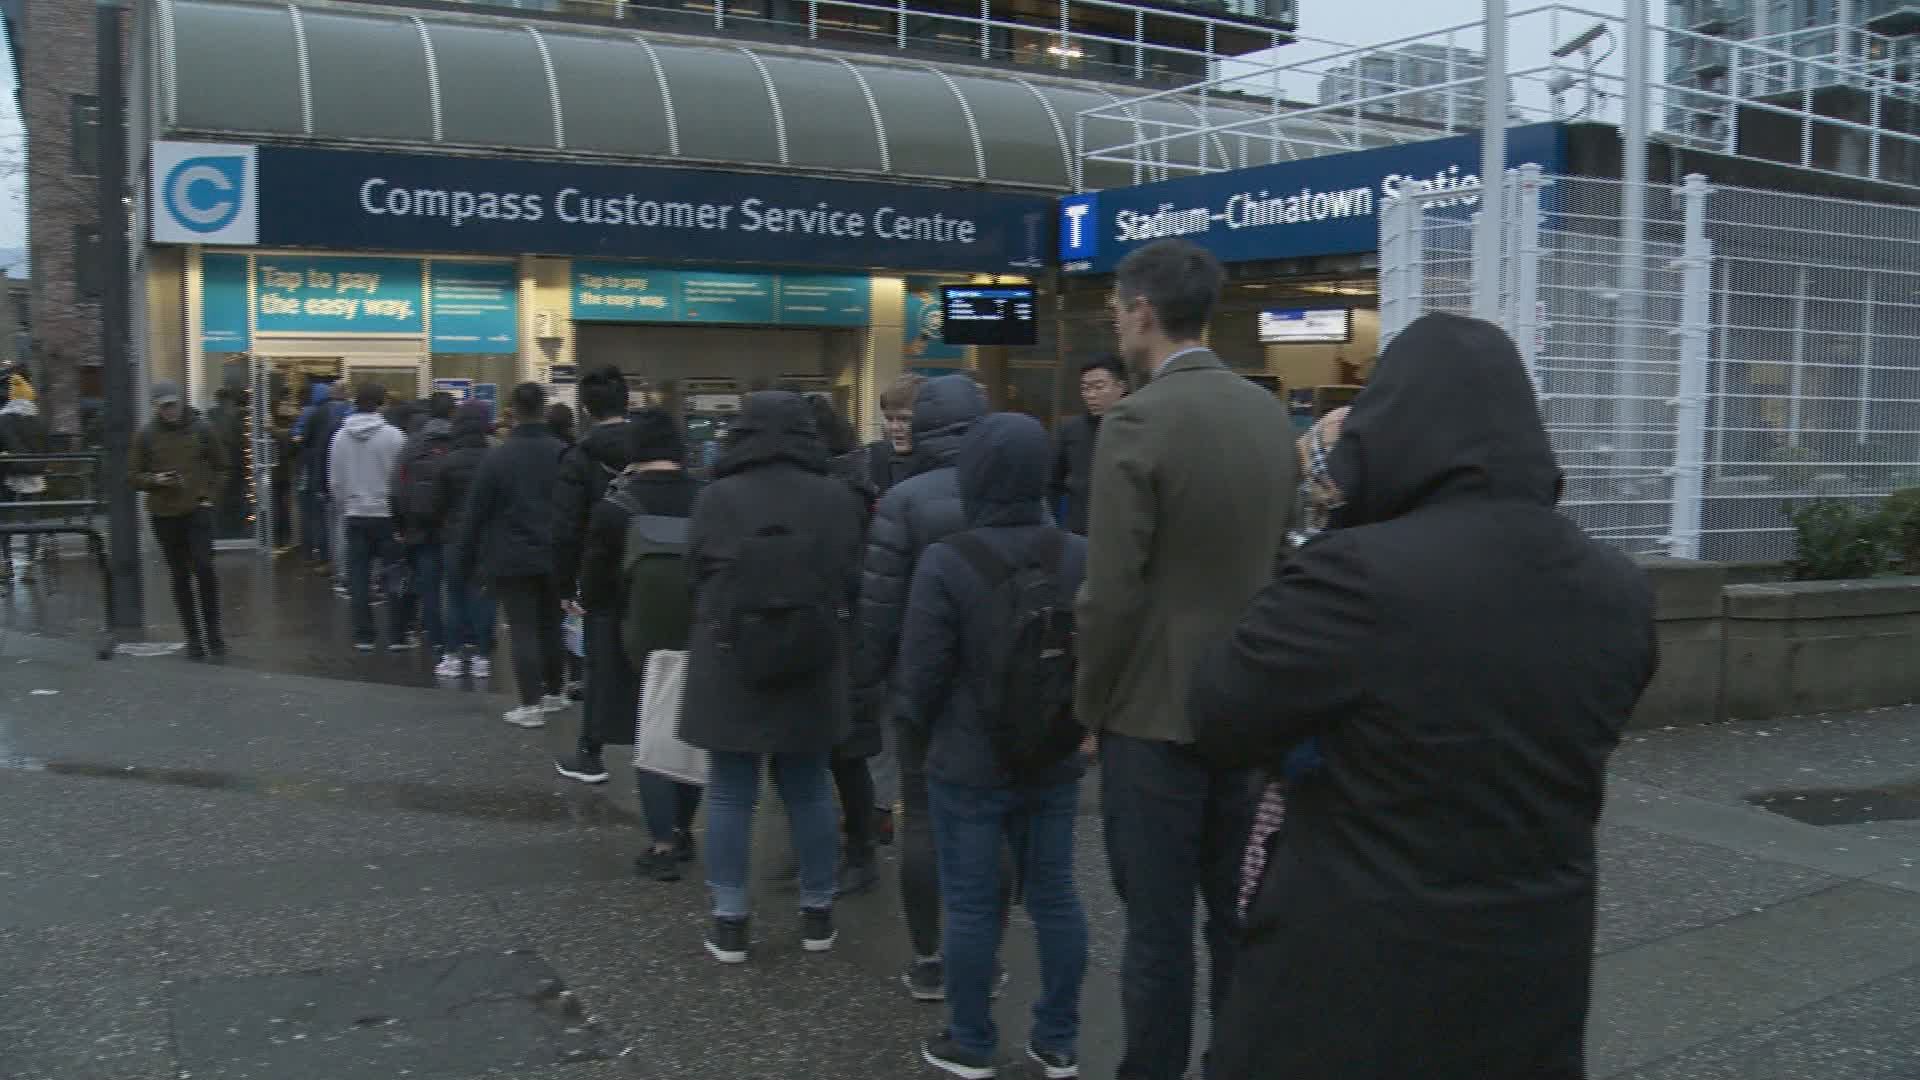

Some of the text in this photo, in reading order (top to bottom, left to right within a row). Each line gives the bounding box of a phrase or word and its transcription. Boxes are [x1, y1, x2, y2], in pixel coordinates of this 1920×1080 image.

[359, 177, 977, 244] Compass Customer Service Centre
[1381, 164, 1483, 211] Satio
[1064, 203, 1090, 249] T
[260, 266, 381, 295] Tap to pay
[260, 294, 300, 316] the
[304, 298, 361, 320] easy
[363, 300, 416, 321] way.
